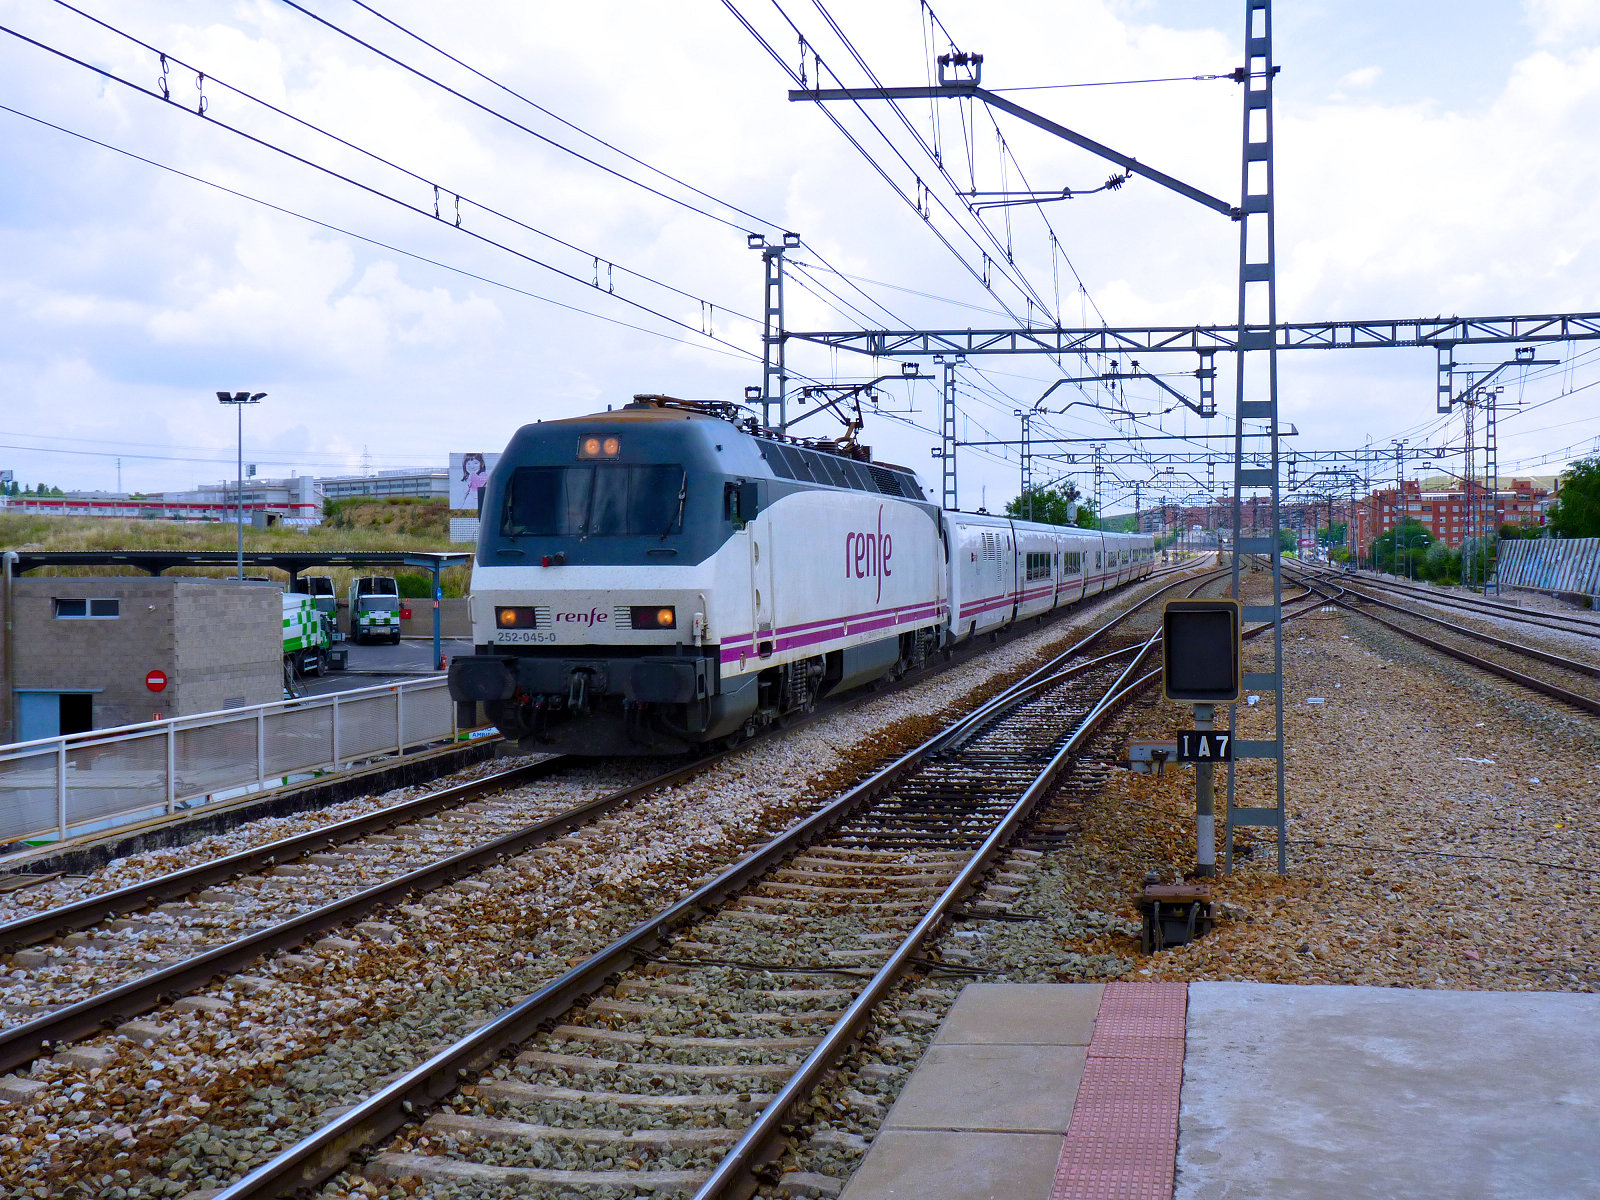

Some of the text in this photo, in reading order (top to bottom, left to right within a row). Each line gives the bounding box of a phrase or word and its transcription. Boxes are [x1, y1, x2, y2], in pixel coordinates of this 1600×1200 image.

[845, 503, 893, 605] renfe
[556, 607, 609, 628] renfe
[498, 632, 556, 642] 252-045-0
